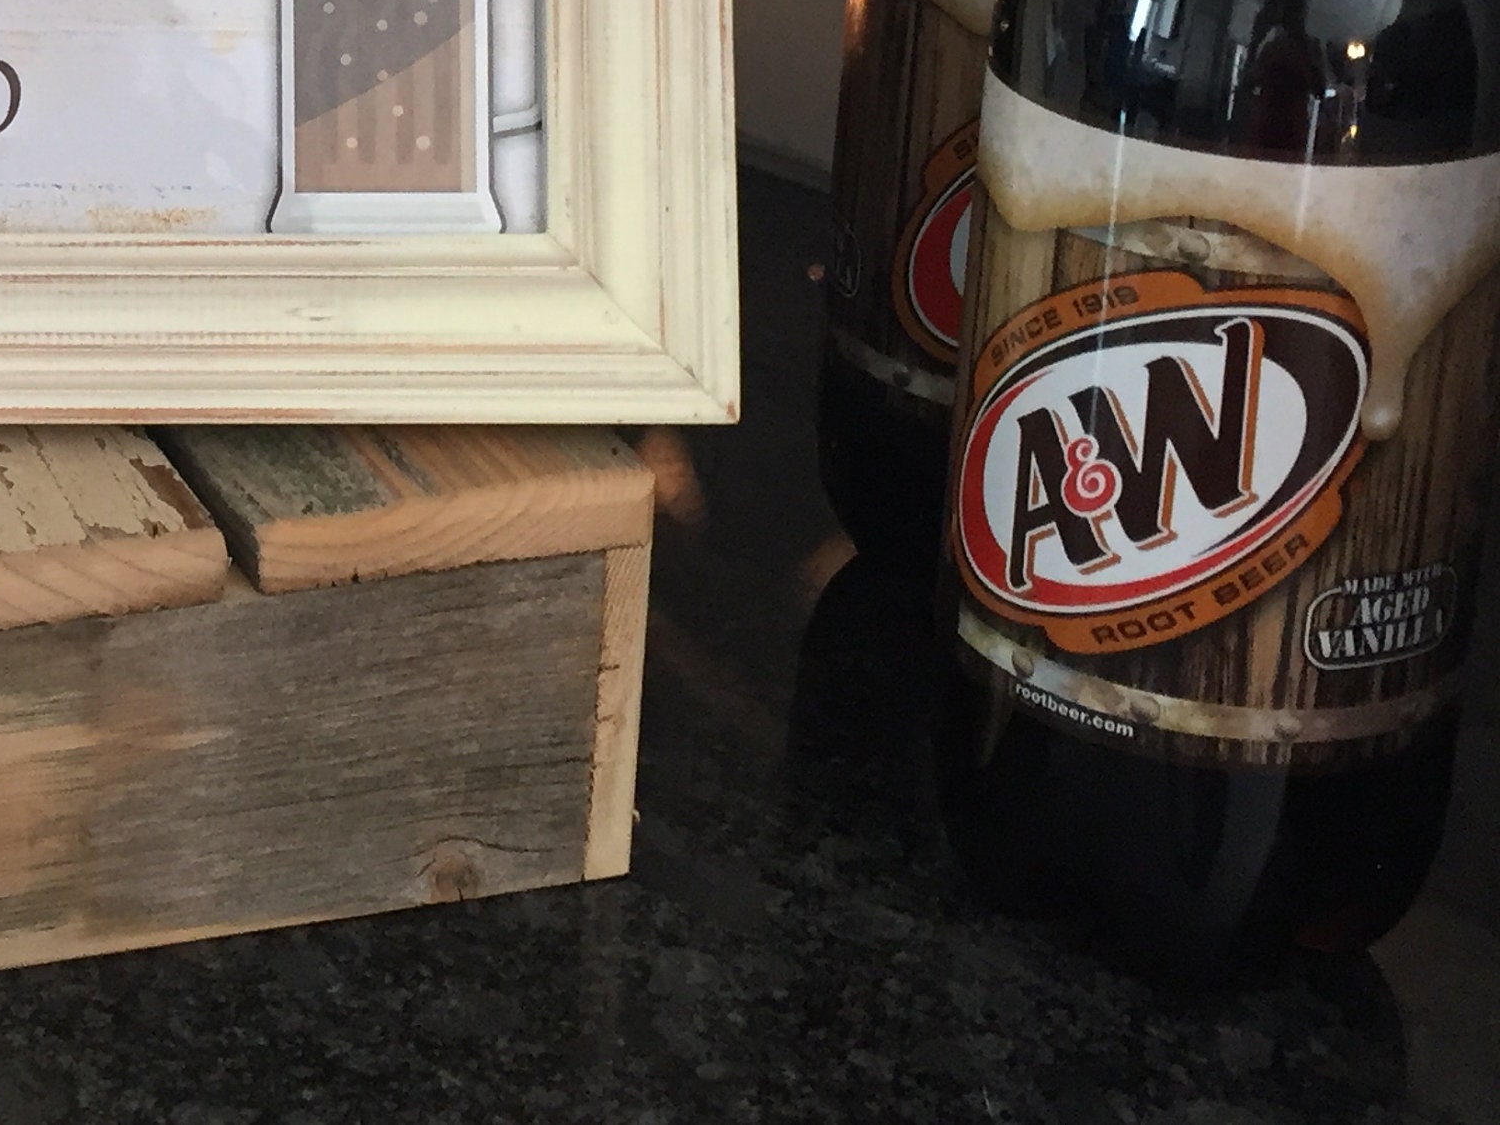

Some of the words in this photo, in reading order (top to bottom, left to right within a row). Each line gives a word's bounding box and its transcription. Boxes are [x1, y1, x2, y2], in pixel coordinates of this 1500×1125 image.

[989, 307, 1063, 368] SINCE
[1006, 316, 1266, 595] A&W
[1091, 601, 1197, 646] ROOT
[1211, 533, 1309, 607] BEER
[1350, 586, 1431, 627] AGED
[1014, 682, 1136, 739] rootbeer.com
